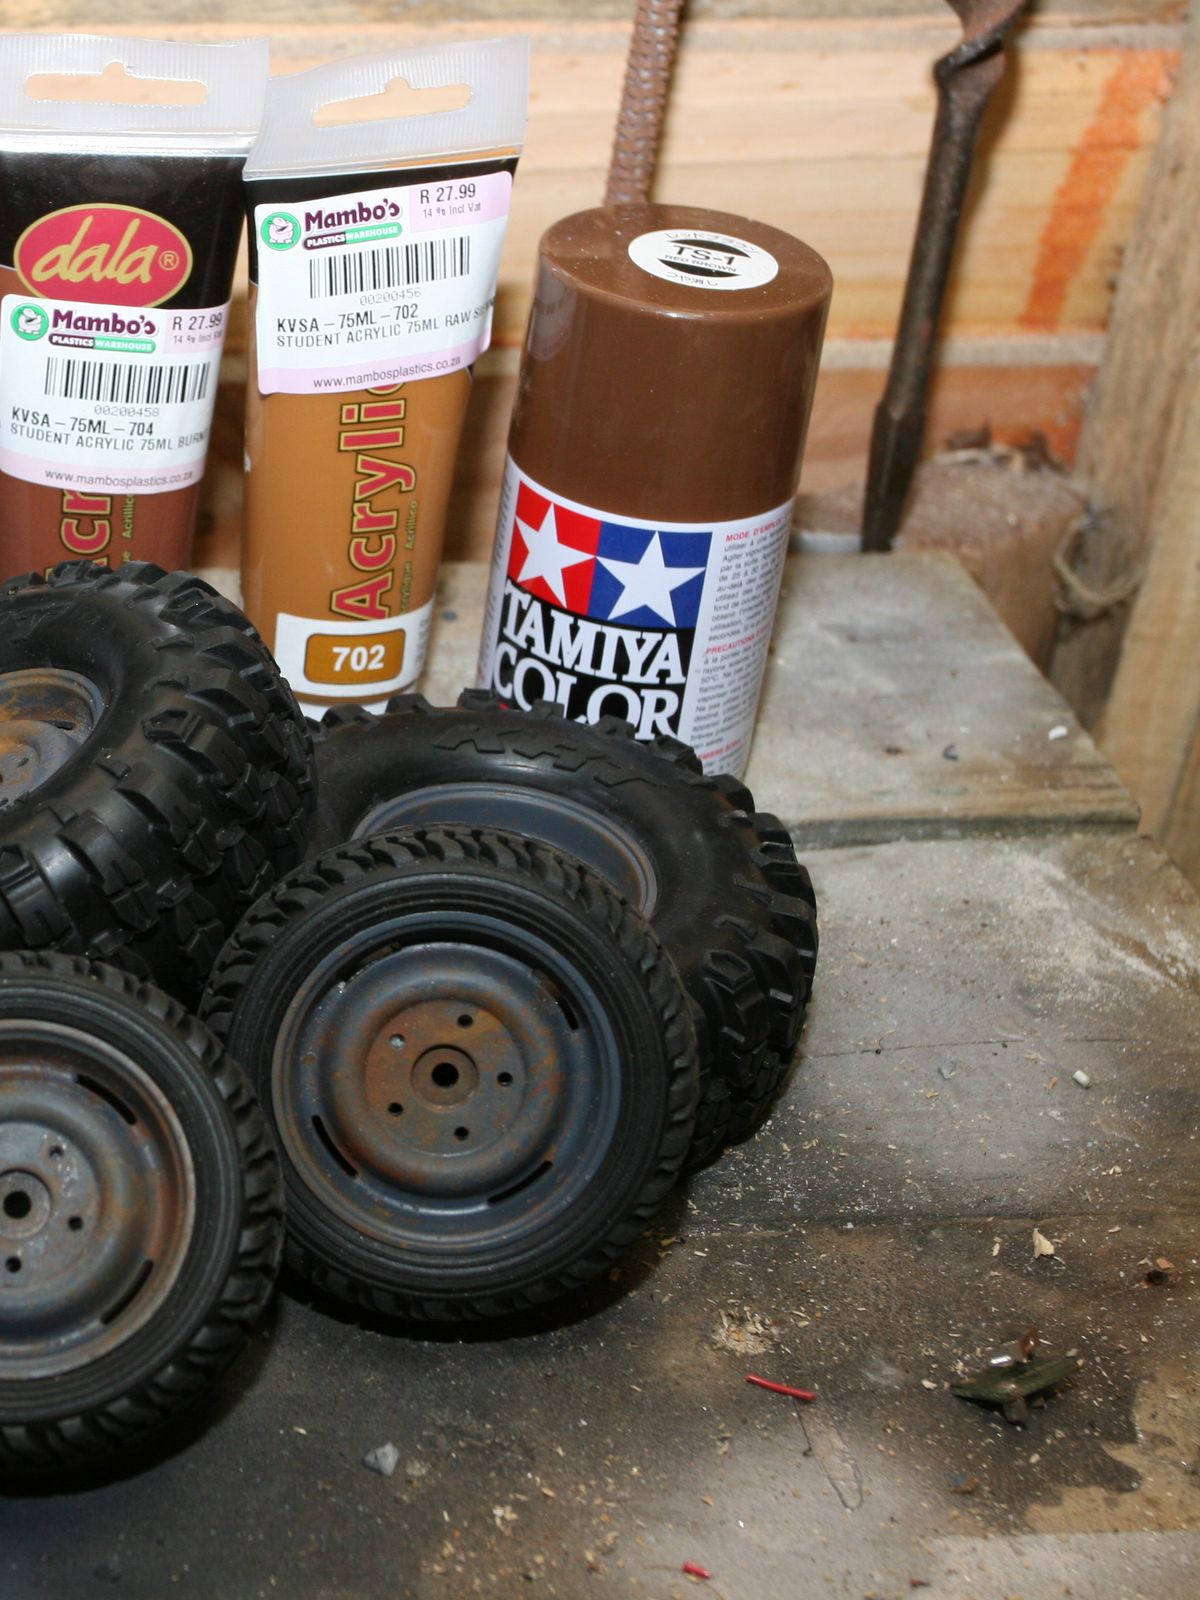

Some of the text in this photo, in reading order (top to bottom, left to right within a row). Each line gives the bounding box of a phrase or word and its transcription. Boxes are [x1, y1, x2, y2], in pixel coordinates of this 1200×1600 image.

[420, 183, 476, 204] R 27.99
[304, 198, 400, 232] Mambo's
[423, 208, 432, 218] 14
[307, 225, 399, 247] PLASTICS WAREHOUSE
[31, 215, 159, 284] dala
[673, 245, 736, 266] TS-1
[664, 254, 737, 273] RED BROWN
[359, 287, 422, 306] 00200456
[52, 309, 156, 335] Mambo's
[172, 312, 222, 331] R 27.99
[277, 332, 341, 348] STUDENT
[346, 323, 401, 344] ACRYLIC
[407, 317, 439, 334] 75ML
[445, 310, 471, 327] RAW
[52, 335, 153, 352] PLASTICS WAREHOUSE
[173, 335, 182, 344] 14
[313, 355, 461, 389] www.mambosplastics.co.za
[94, 405, 160, 418] 00200458
[10, 423, 71, 446] STUDENT
[75, 435, 135, 451] ACRYLIC
[140, 435, 173, 451] 75ML
[45, 469, 193, 489] www.mambosplastics.co.za
[725, 530, 749, 542] MODE
[504, 579, 686, 684] TAMIYA
[332, 644, 385, 672] 702
